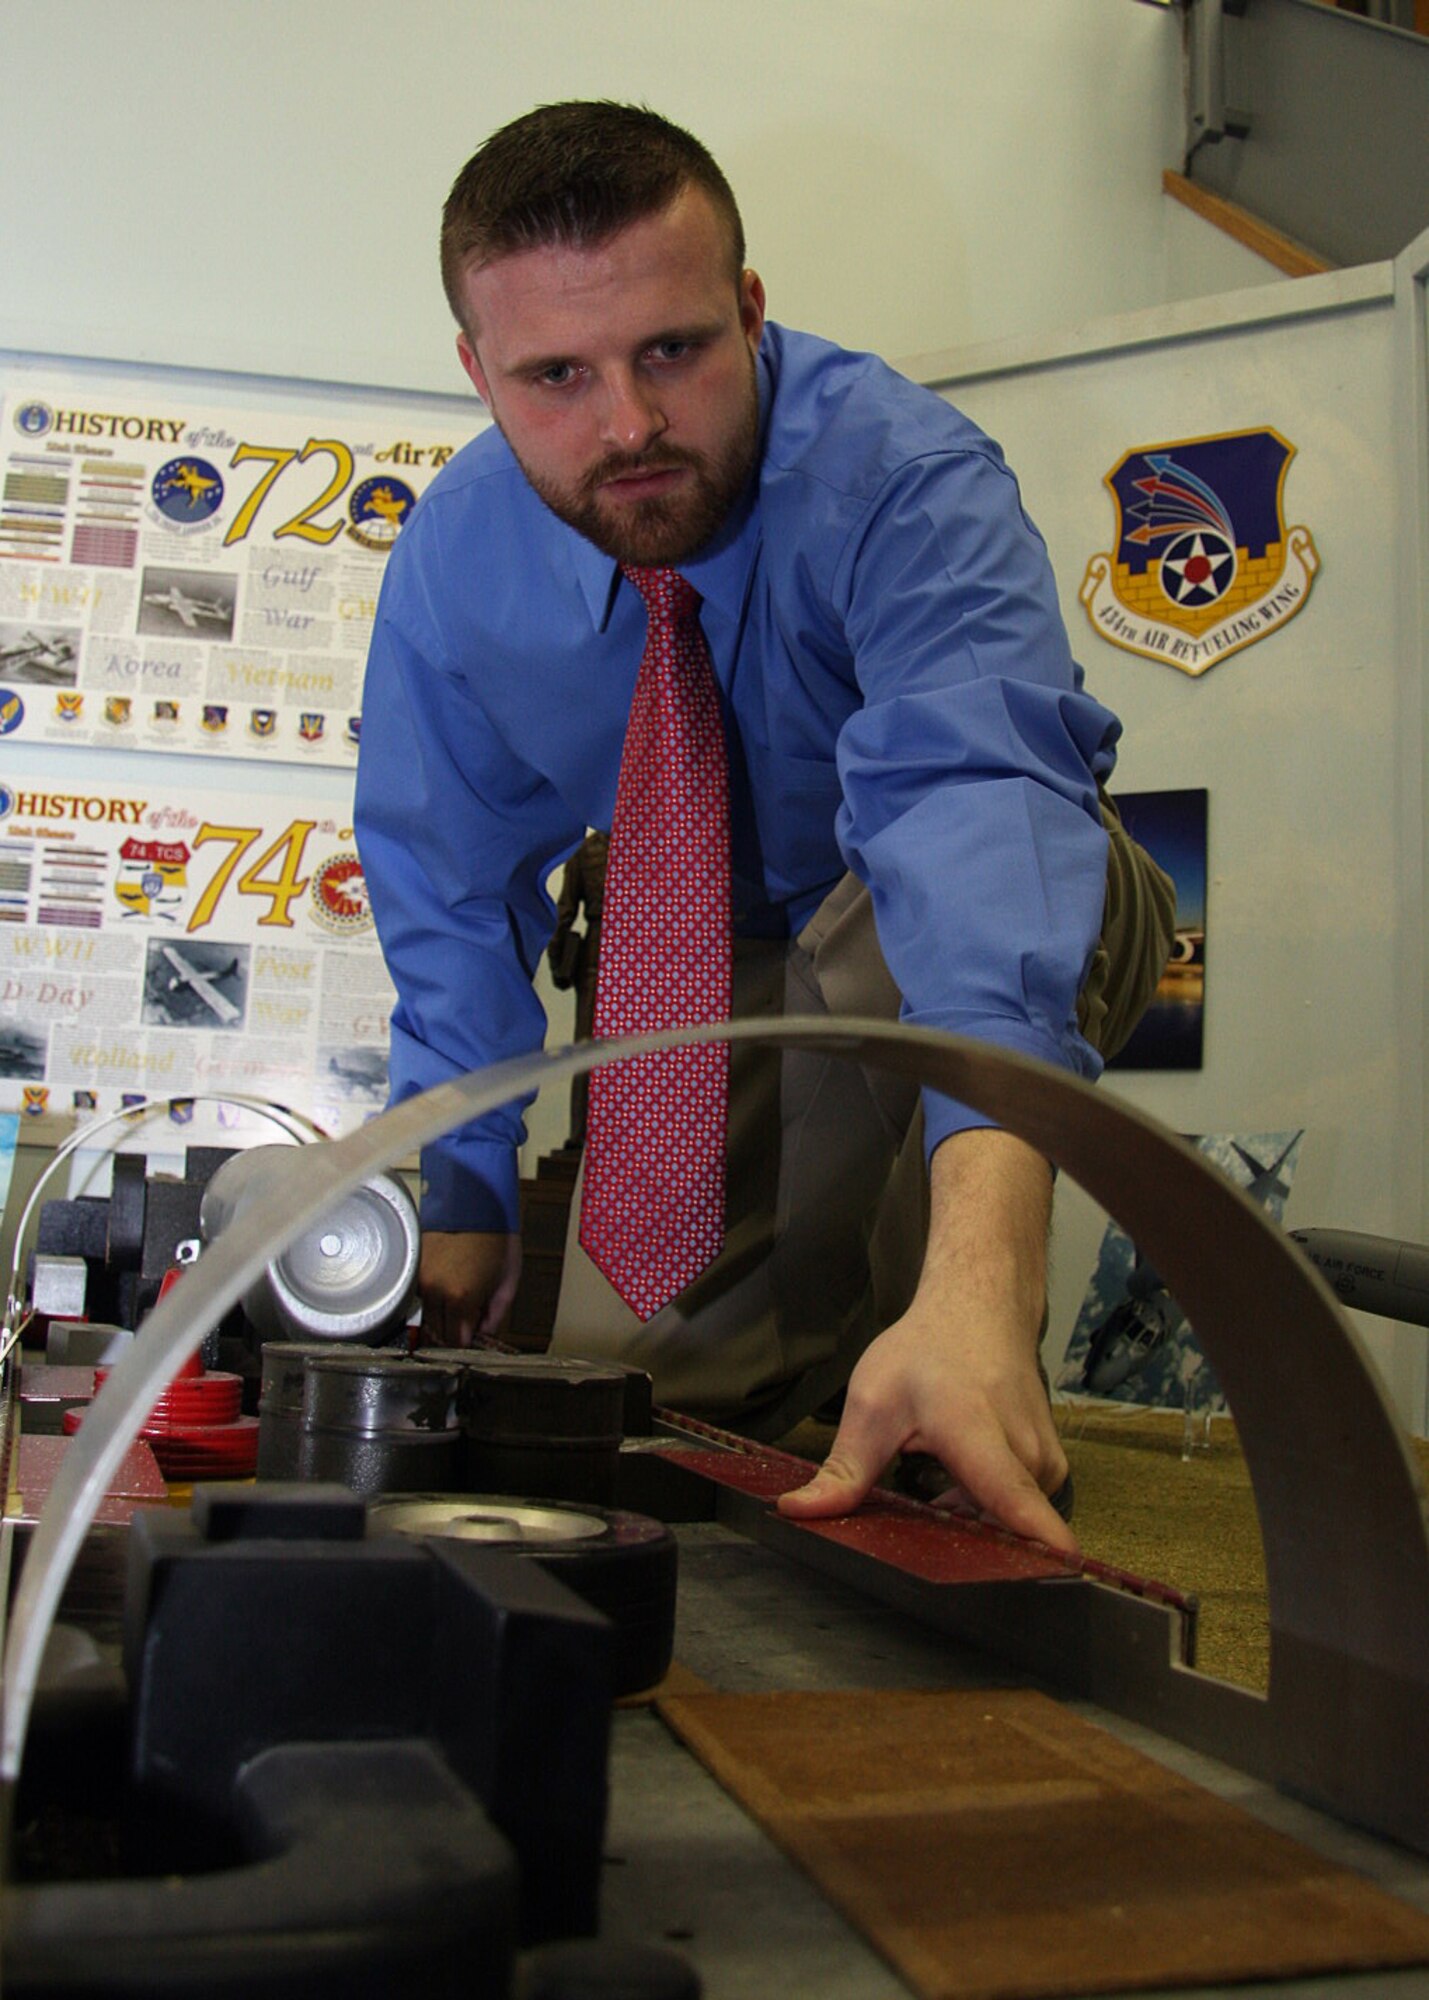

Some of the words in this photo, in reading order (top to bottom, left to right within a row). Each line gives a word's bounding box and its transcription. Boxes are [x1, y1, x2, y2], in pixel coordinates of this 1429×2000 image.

[54, 410, 186, 443] HISTORY
[374, 441, 424, 466] Air
[262, 564, 322, 593] Gulf
[260, 607, 316, 630] War
[1142, 629, 1168, 651] AIR
[1171, 614, 1259, 662] REFUELING
[1260, 584, 1300, 621] WING
[104, 654, 183, 680] Korea
[225, 660, 336, 692] Vietnam
[15, 792, 148, 825] HISTORY
